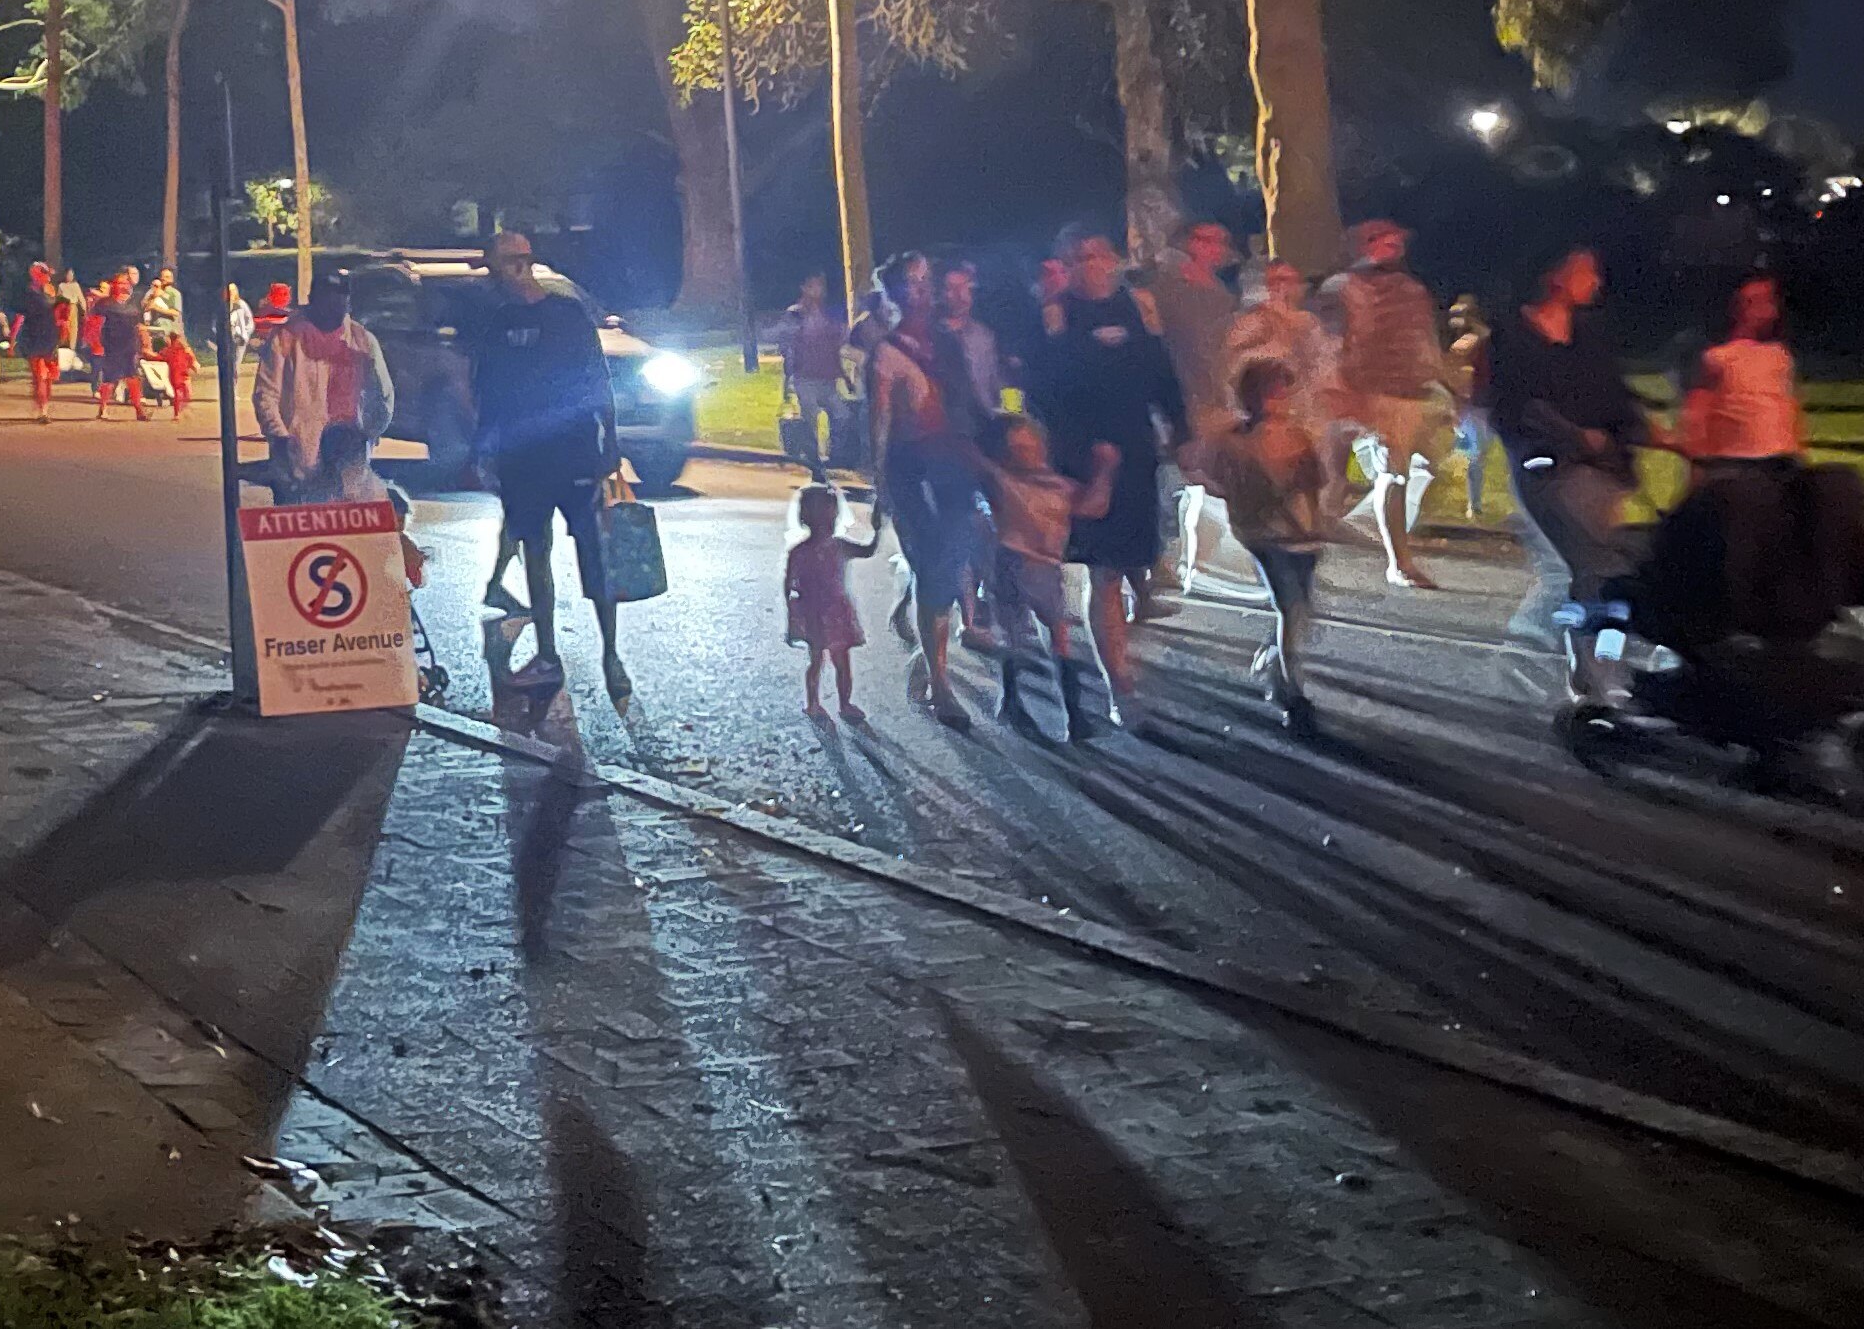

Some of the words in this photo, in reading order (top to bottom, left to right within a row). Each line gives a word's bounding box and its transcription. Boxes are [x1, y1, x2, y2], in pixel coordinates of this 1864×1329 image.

[258, 508, 380, 534] ATTENTION
[264, 636, 326, 657] Fraser
[332, 632, 405, 653] Avenue
